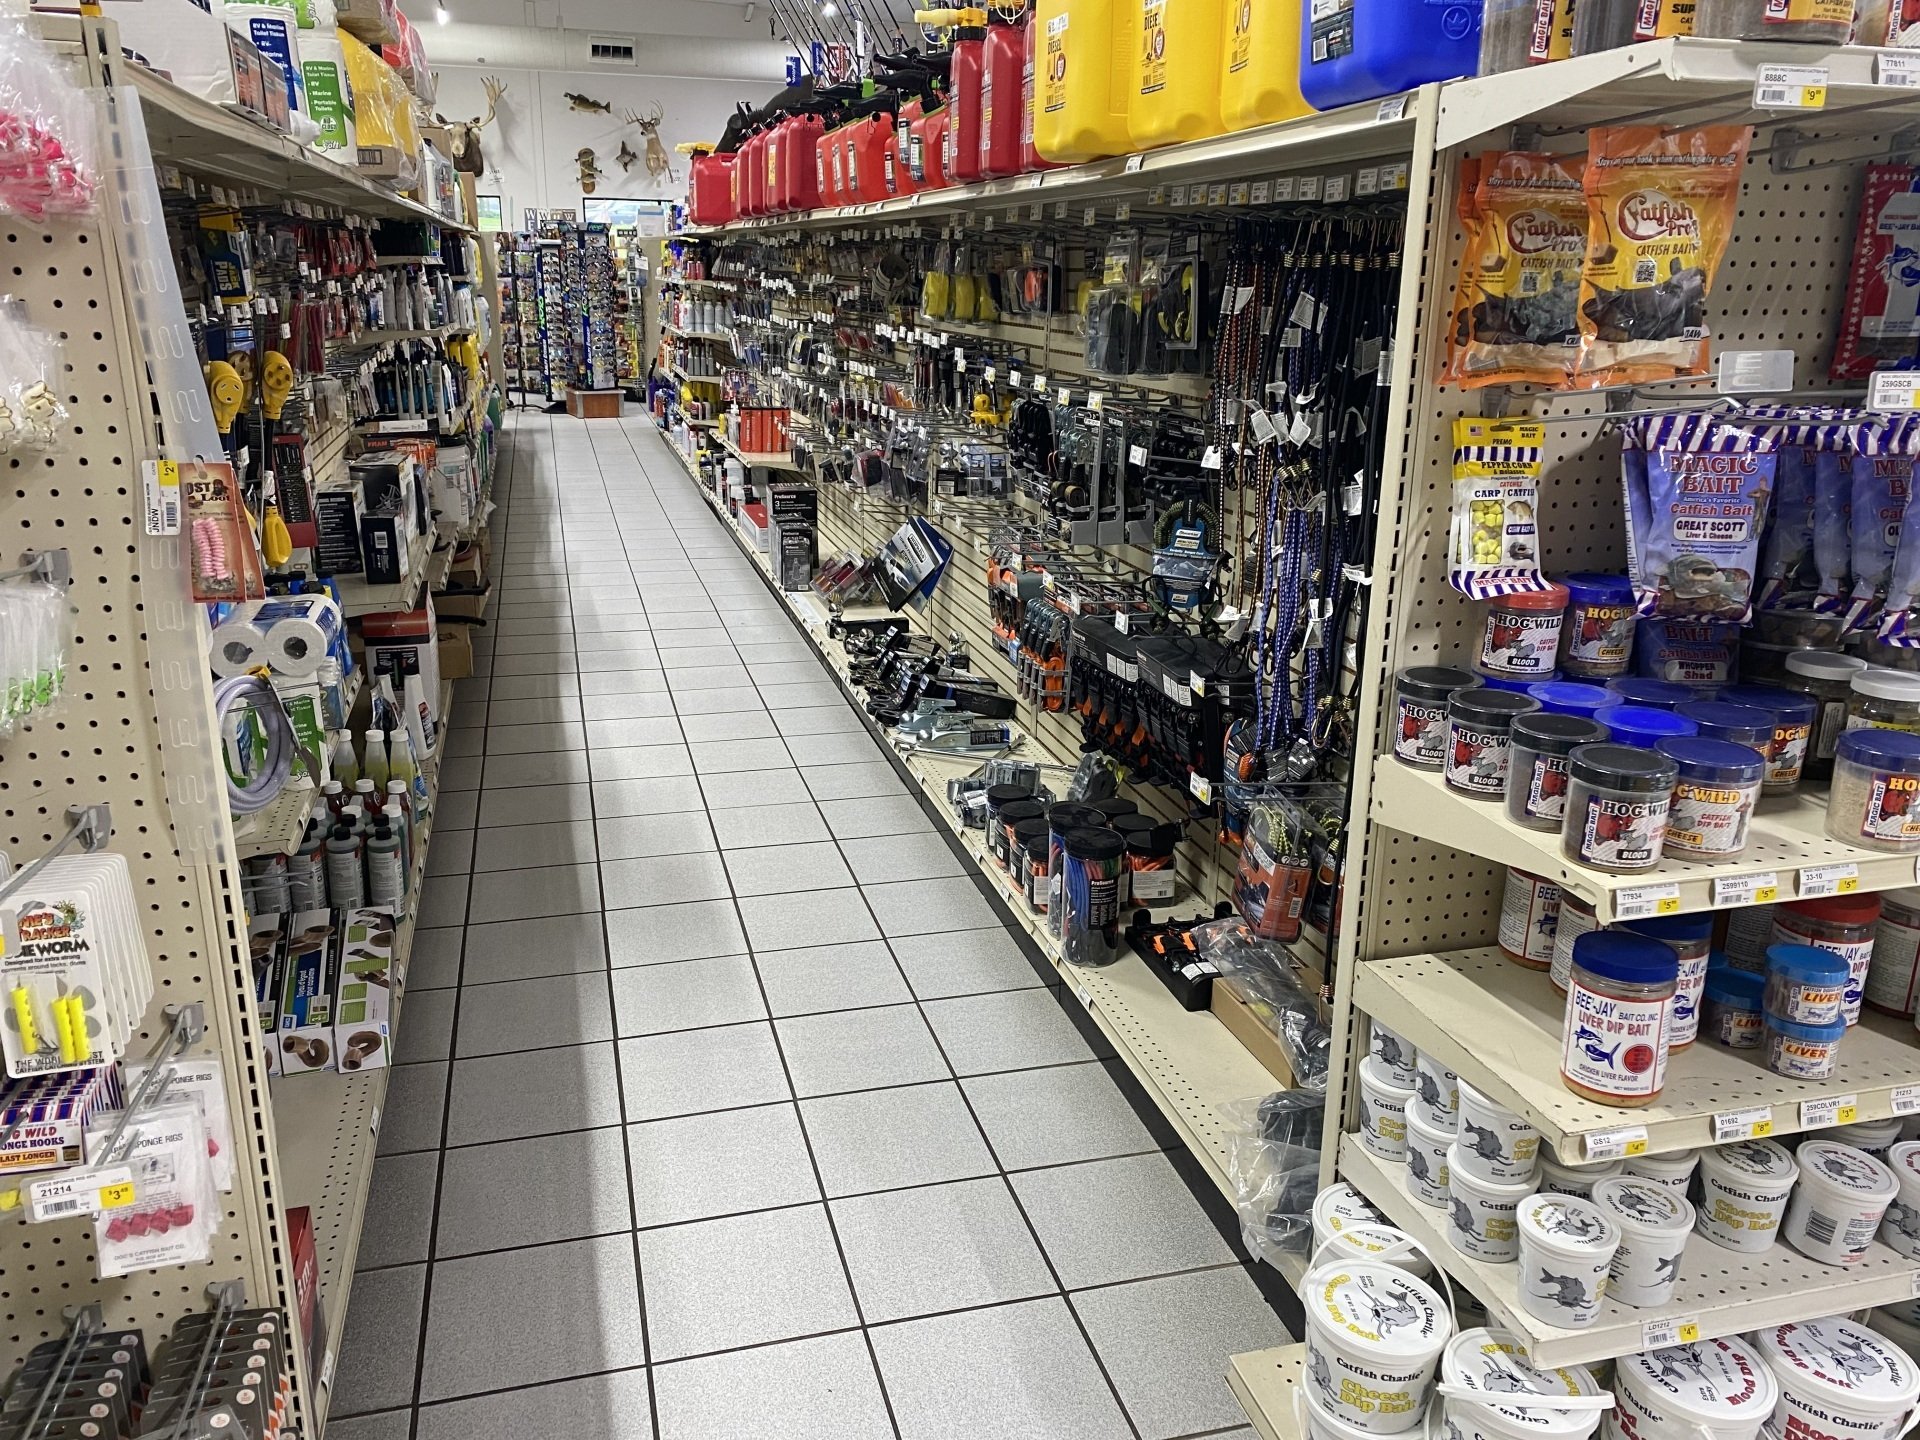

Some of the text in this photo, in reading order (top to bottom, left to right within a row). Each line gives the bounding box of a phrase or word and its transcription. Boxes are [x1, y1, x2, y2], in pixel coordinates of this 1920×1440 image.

[1536, 20, 1547, 50] MAGIC
[1886, 59, 1906, 68] 77811
[1764, 73, 1787, 83] 8888C
[1618, 190, 1694, 242] Catfish
[1506, 209, 1584, 254] Catfish
[1636, 245, 1669, 257] CATFISH
[1670, 456, 1758, 474] MAGIC
[1682, 476, 1744, 494] BAIT
[1474, 489, 1500, 498] CARP
[1670, 504, 1753, 516] Catfish Bait
[151, 508, 160, 532] JNDW
[1676, 520, 1746, 532] GREAT SCOTT
[1588, 607, 1620, 619] HOG
[1497, 614, 1562, 629] HOG WILD
[1664, 625, 1713, 642] BAIT
[1511, 657, 1536, 666] BLOOD
[1678, 661, 1716, 671] WHOPPER
[1683, 671, 1713, 680] Shad
[1406, 704, 1436, 720] HOG
[1458, 729, 1491, 746] HOG
[1420, 748, 1444, 758] BLOOD
[1473, 776, 1499, 785] BLOOD
[1693, 789, 1741, 804] WILD
[1601, 800, 1643, 817] HOG
[1869, 784, 1885, 828] MAGIC BAIT
[1586, 808, 1598, 851] MAGIC BAIT
[1667, 830, 1698, 843] CHEESE
[1622, 851, 1648, 860] BLOOD
[1806, 873, 1823, 881] 33-10
[1722, 881, 1749, 890] 2599110
[38, 938, 90, 954] WORM
[5, 957, 34, 966] Designed
[61, 953, 81, 962] strong
[1803, 993, 1840, 1003] LIVER
[1619, 1012, 1635, 1021] BAIT
[1579, 1012, 1651, 1036] LIVER DIP BAIT
[1785, 1044, 1827, 1058] LIVER
[15, 1059, 32, 1069] THE
[1601, 1070, 1617, 1081] LIVER
[1618, 1074, 1638, 1082] FLAVOR
[25, 1126, 57, 1138] WILD
[166, 1133, 184, 1142] RIGS
[1, 1137, 65, 1151] ONGE HOOKS
[1593, 1137, 1611, 1146] GS12
[0, 1151, 55, 1163] LAST LONGER
[40, 1185, 72, 1198] 21214
[1711, 1178, 1751, 1201] Catfish
[1715, 1198, 1773, 1220] Cheese
[1713, 1209, 1778, 1231] Dip Bait
[1392, 1278, 1436, 1340] Catfish Charlie
[1838, 1327, 1883, 1358] Catfish
[1336, 1356, 1421, 1382] Catfish Charlie
[1342, 1378, 1409, 1401] Cheese
[1340, 1391, 1415, 1414] Dip Bait
[1624, 1388, 1661, 1422] Charlie
[1784, 1391, 1880, 1431] Catfish Charlie
